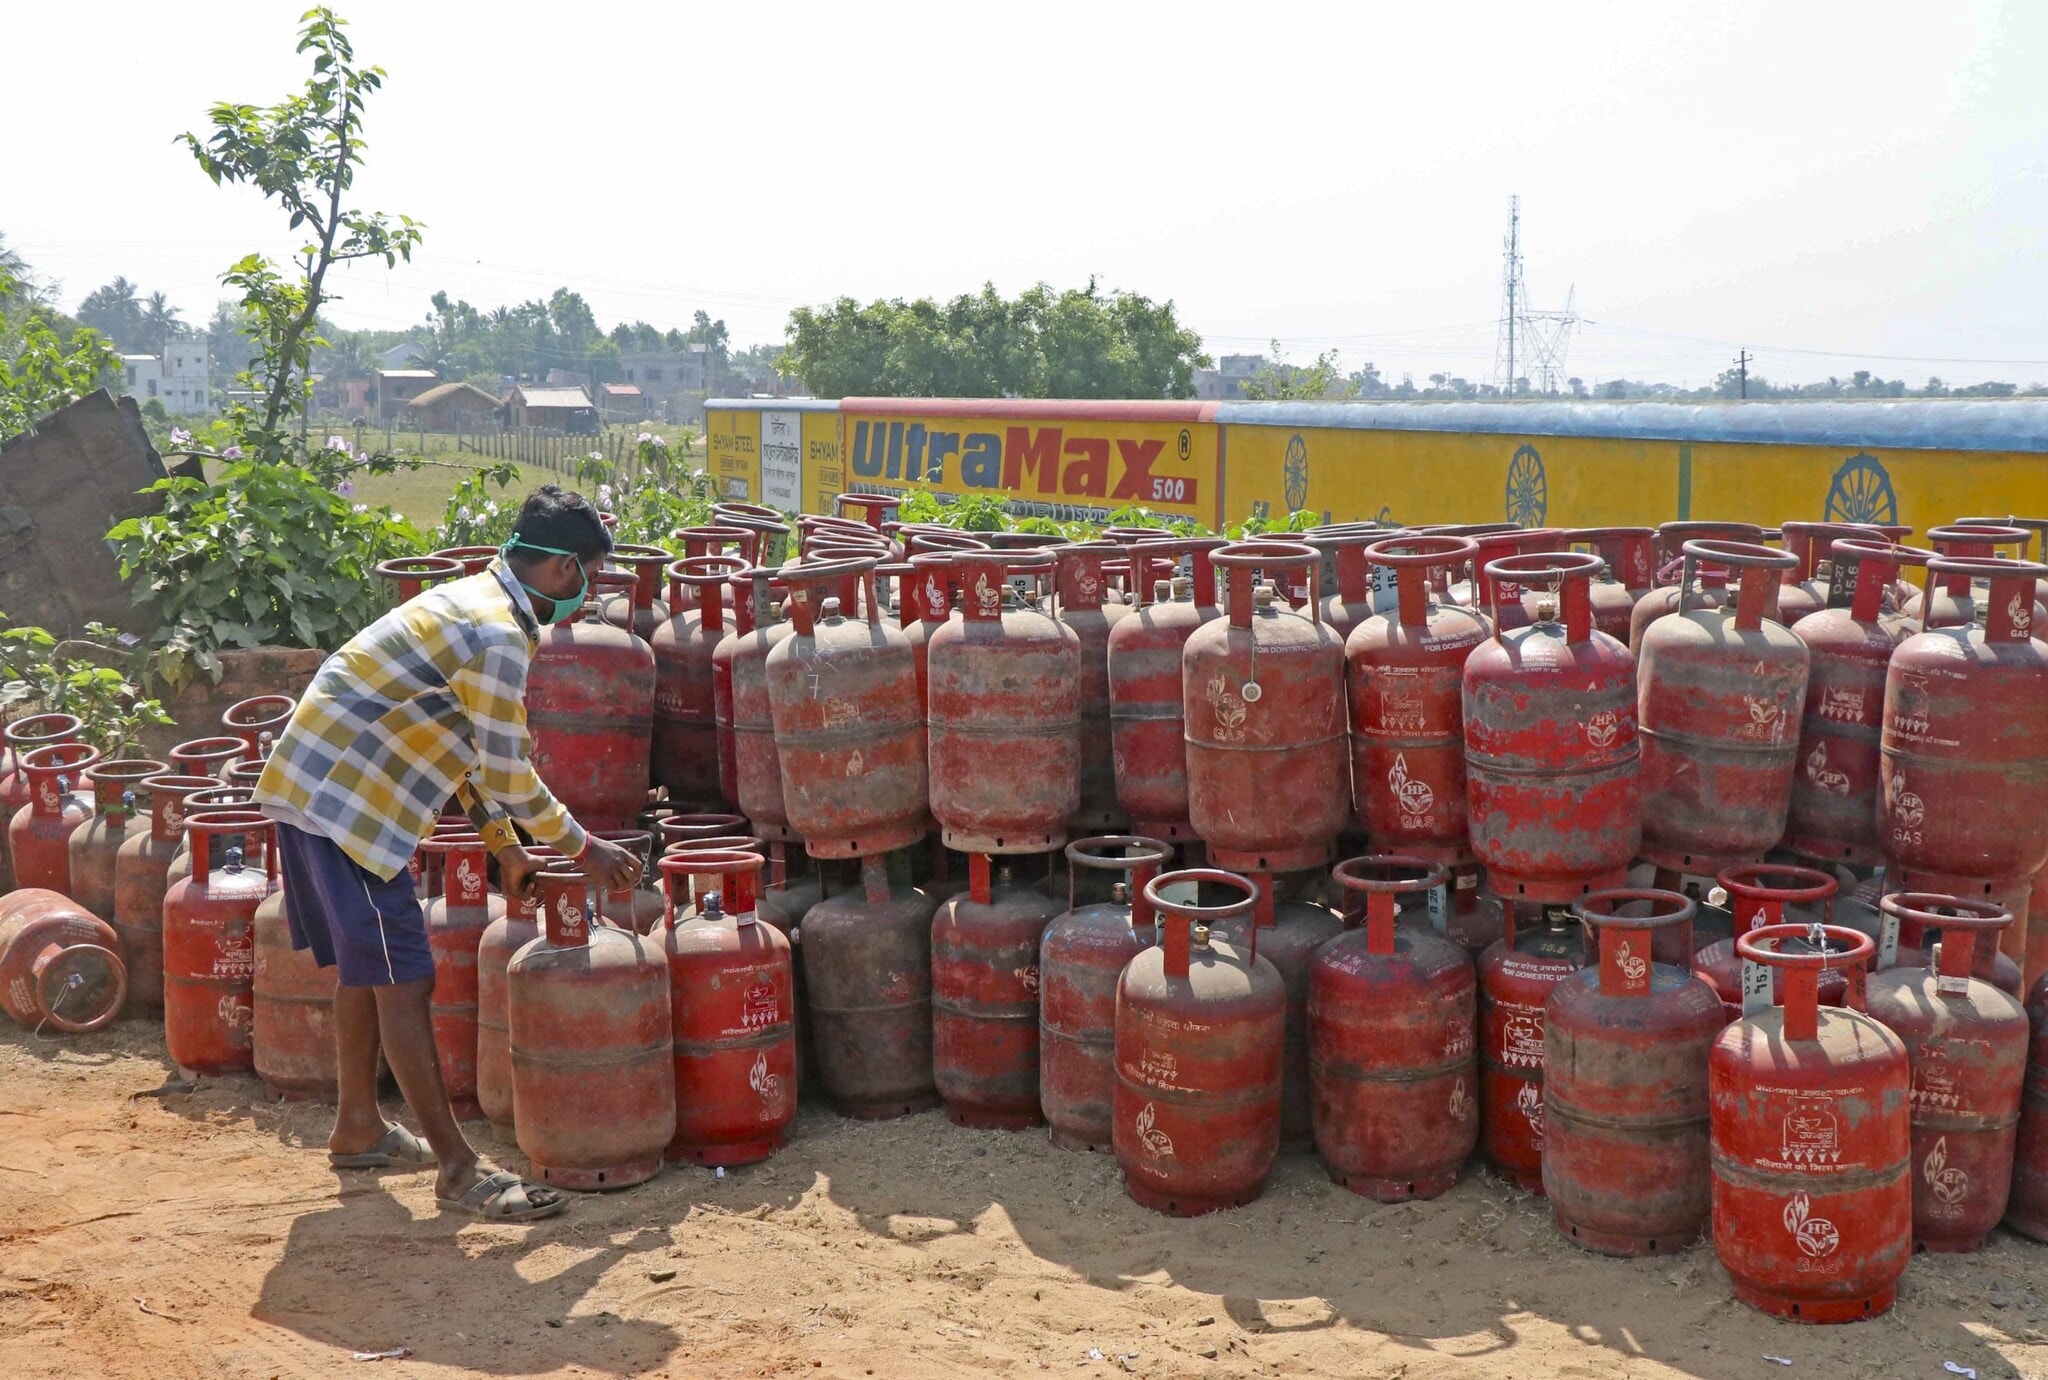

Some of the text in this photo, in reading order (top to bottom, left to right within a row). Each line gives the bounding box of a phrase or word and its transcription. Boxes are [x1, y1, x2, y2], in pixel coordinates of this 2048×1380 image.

[810, 440, 838, 462] SHYAM
[852, 420, 1167, 501] UltraMax
[1153, 477, 1185, 501] 500
[1833, 564, 1844, 595] D-27
[1845, 566, 1859, 598] 15.6
[1500, 591, 1519, 600] GAS
[2010, 629, 2029, 638] GAS
[1424, 637, 1477, 653] FOR DOMESTIC
[1213, 726, 1246, 742] GAS
[1407, 784, 1427, 795] HP
[1400, 814, 1436, 829] GAS
[1893, 827, 1922, 845] GAS
[1502, 967, 1515, 977] FOR
[1515, 969, 1555, 981] DOMESTIC
[1840, 1055, 1858, 1064] FOR
[1807, 1223, 1832, 1235] HP
[1797, 1256, 1839, 1274] GAS
